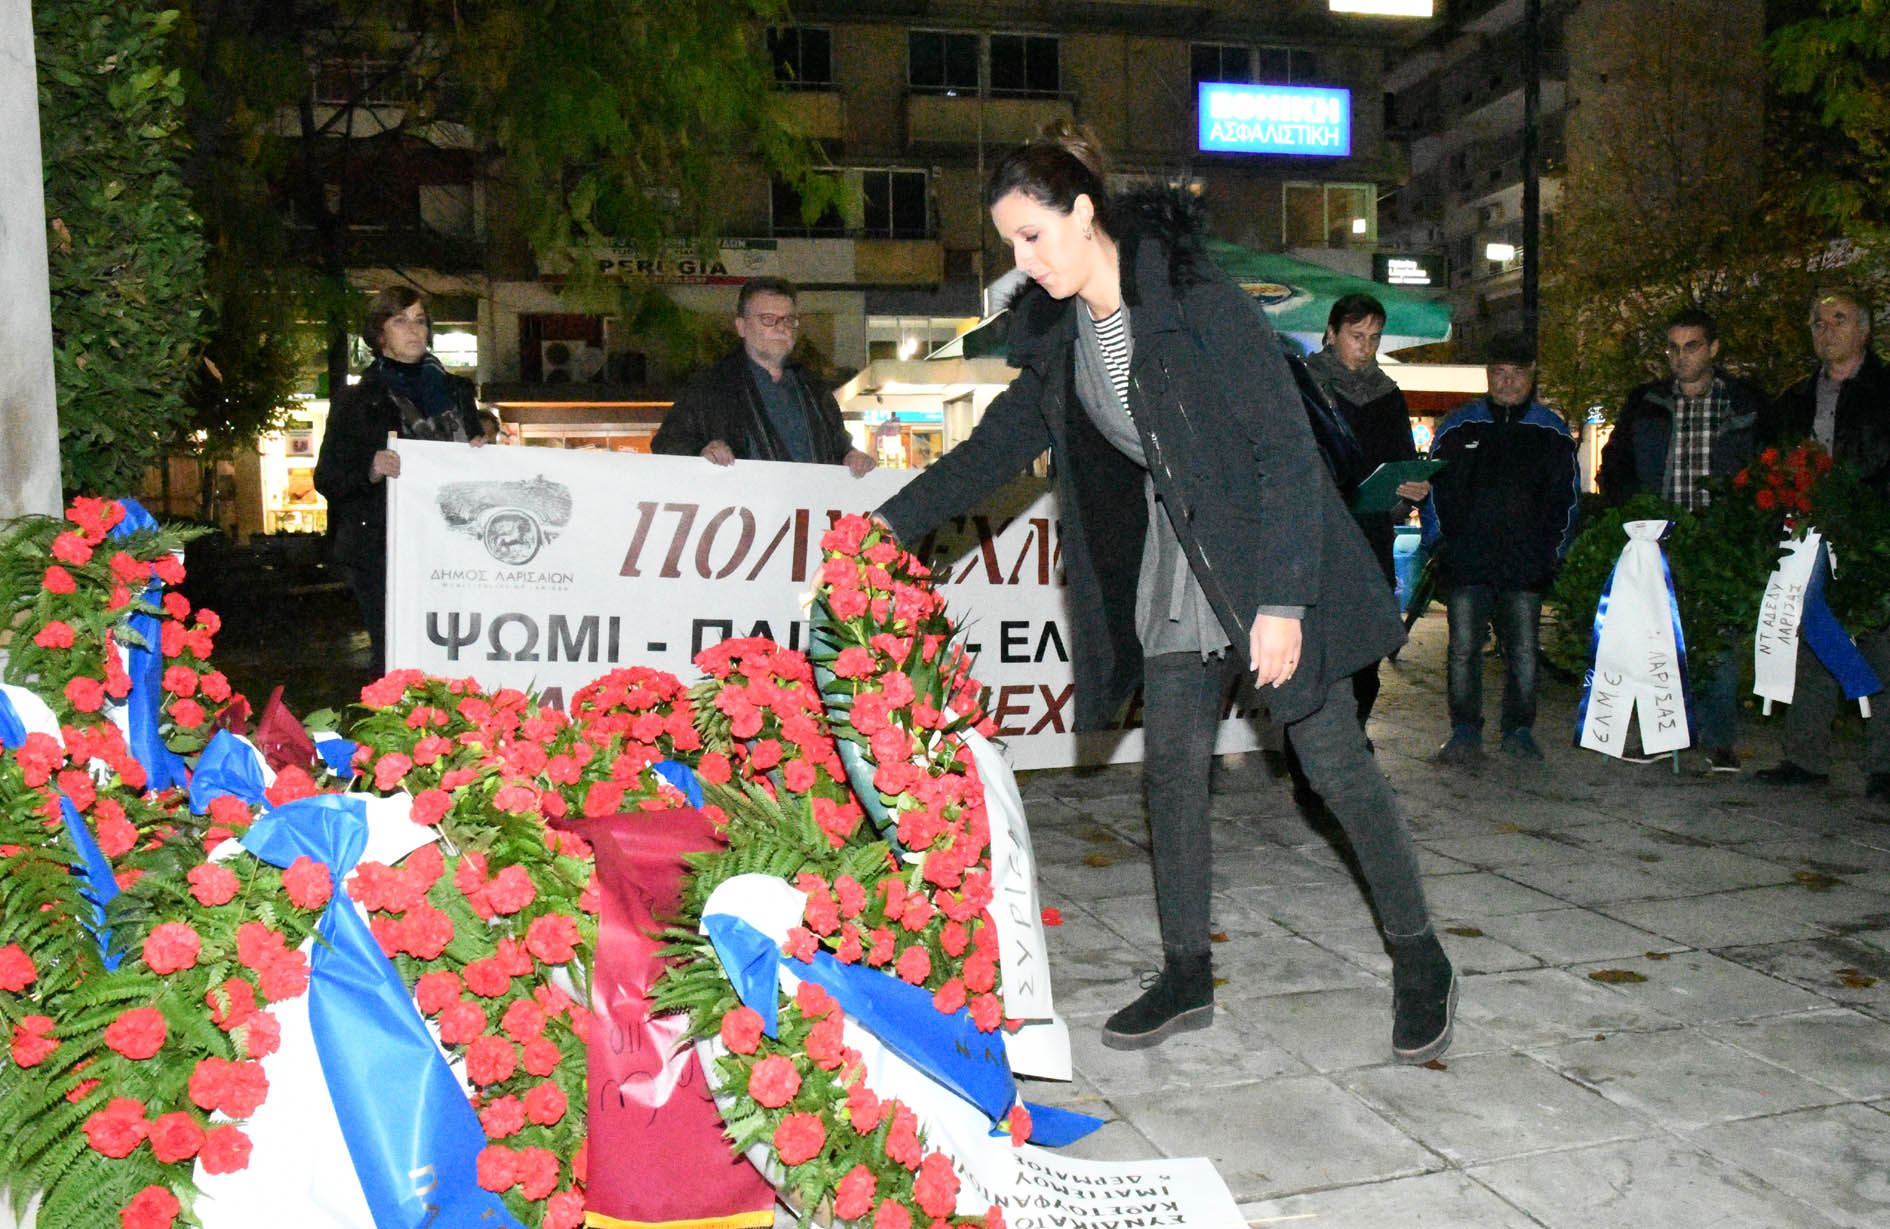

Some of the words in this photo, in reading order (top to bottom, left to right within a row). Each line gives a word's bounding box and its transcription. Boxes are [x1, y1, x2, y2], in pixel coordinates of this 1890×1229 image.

[1209, 120, 1339, 147] ΑΣΦΑΛΙΣΤΙΚΗ
[430, 568, 488, 581] ΔΗΜΟΣ
[496, 570, 575, 584] ΛΑΡΙΣΑΙΩΝ
[426, 612, 621, 663] ΨΩΜΙ
